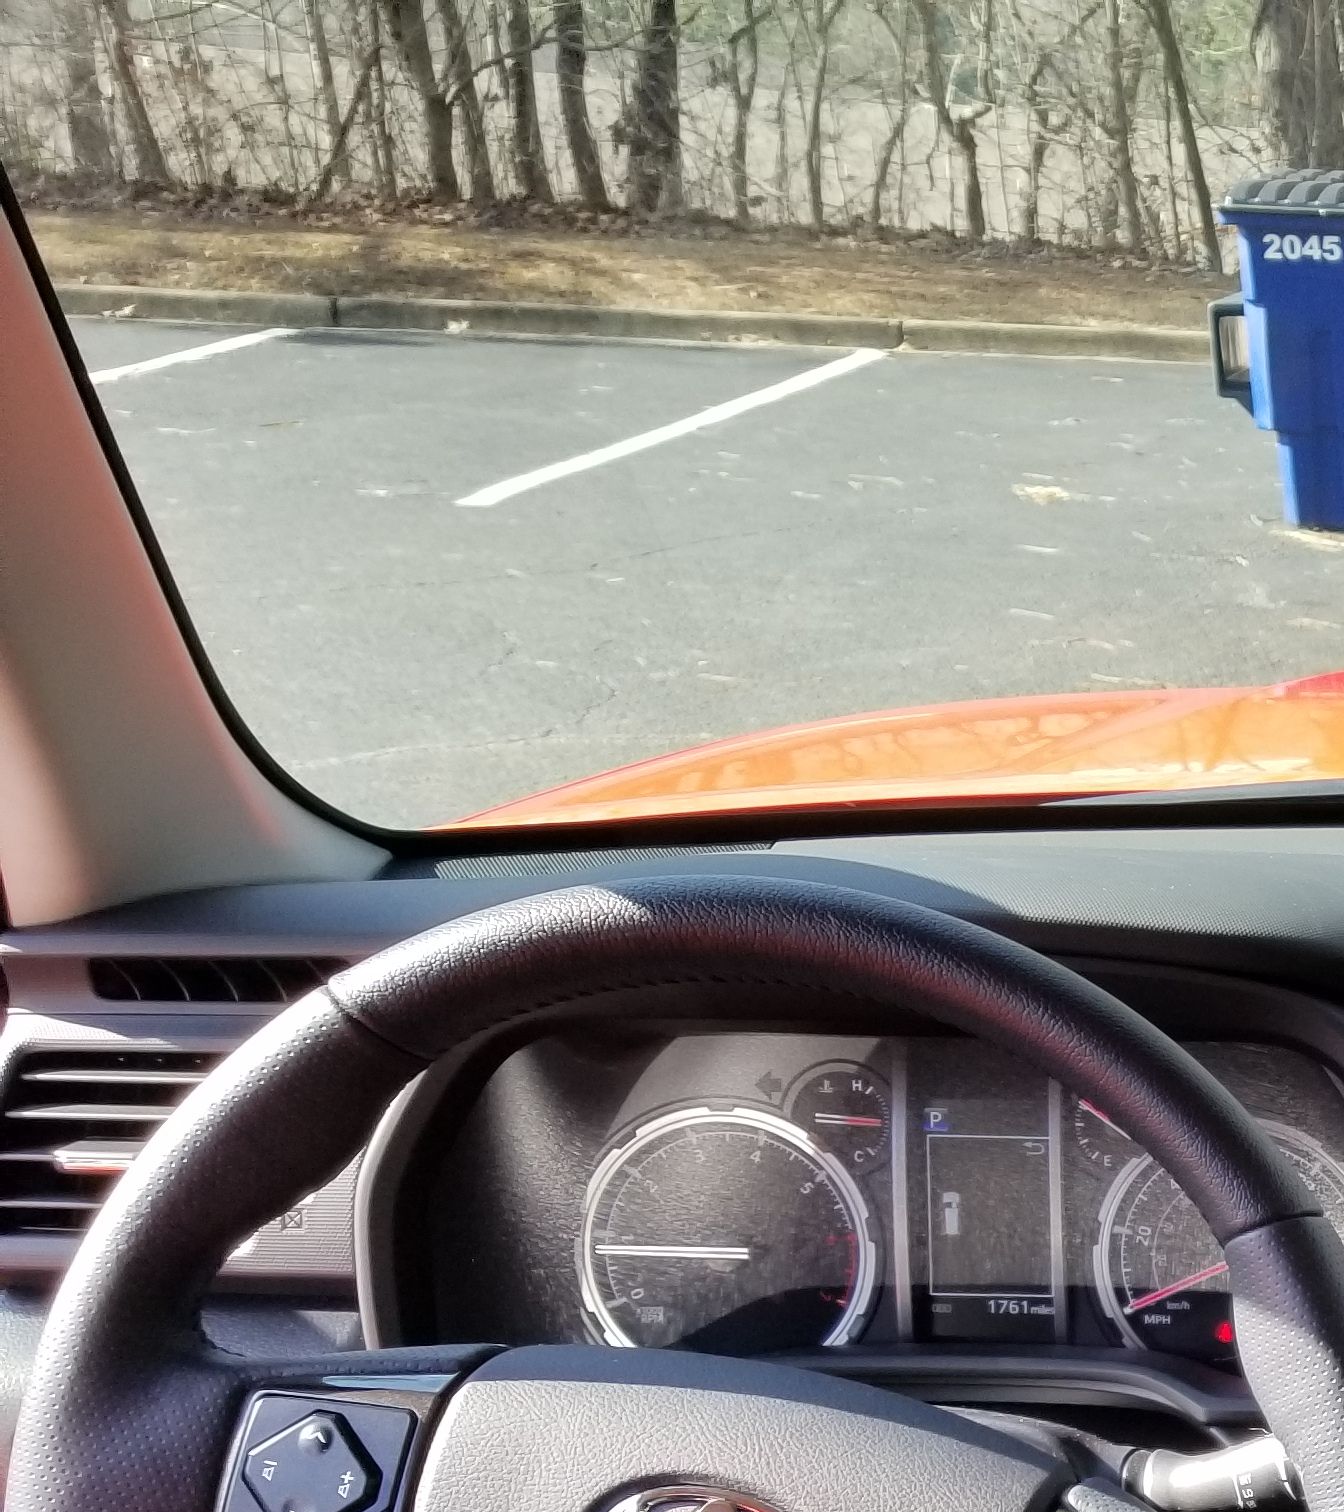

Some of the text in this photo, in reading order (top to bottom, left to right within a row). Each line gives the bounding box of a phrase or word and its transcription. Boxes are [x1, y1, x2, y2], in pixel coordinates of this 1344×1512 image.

[1262, 234, 1343, 262] 2045
[852, 1080, 862, 1091] H
[930, 1112, 942, 1129] P
[750, 1151, 761, 1162] 4
[854, 1151, 864, 1162] C
[800, 1182, 814, 1195] 5
[1136, 1225, 1151, 1246] 20
[631, 1287, 645, 1300] 0
[987, 1299, 1029, 1315] 1761
[1144, 1315, 1171, 1325] MPH
